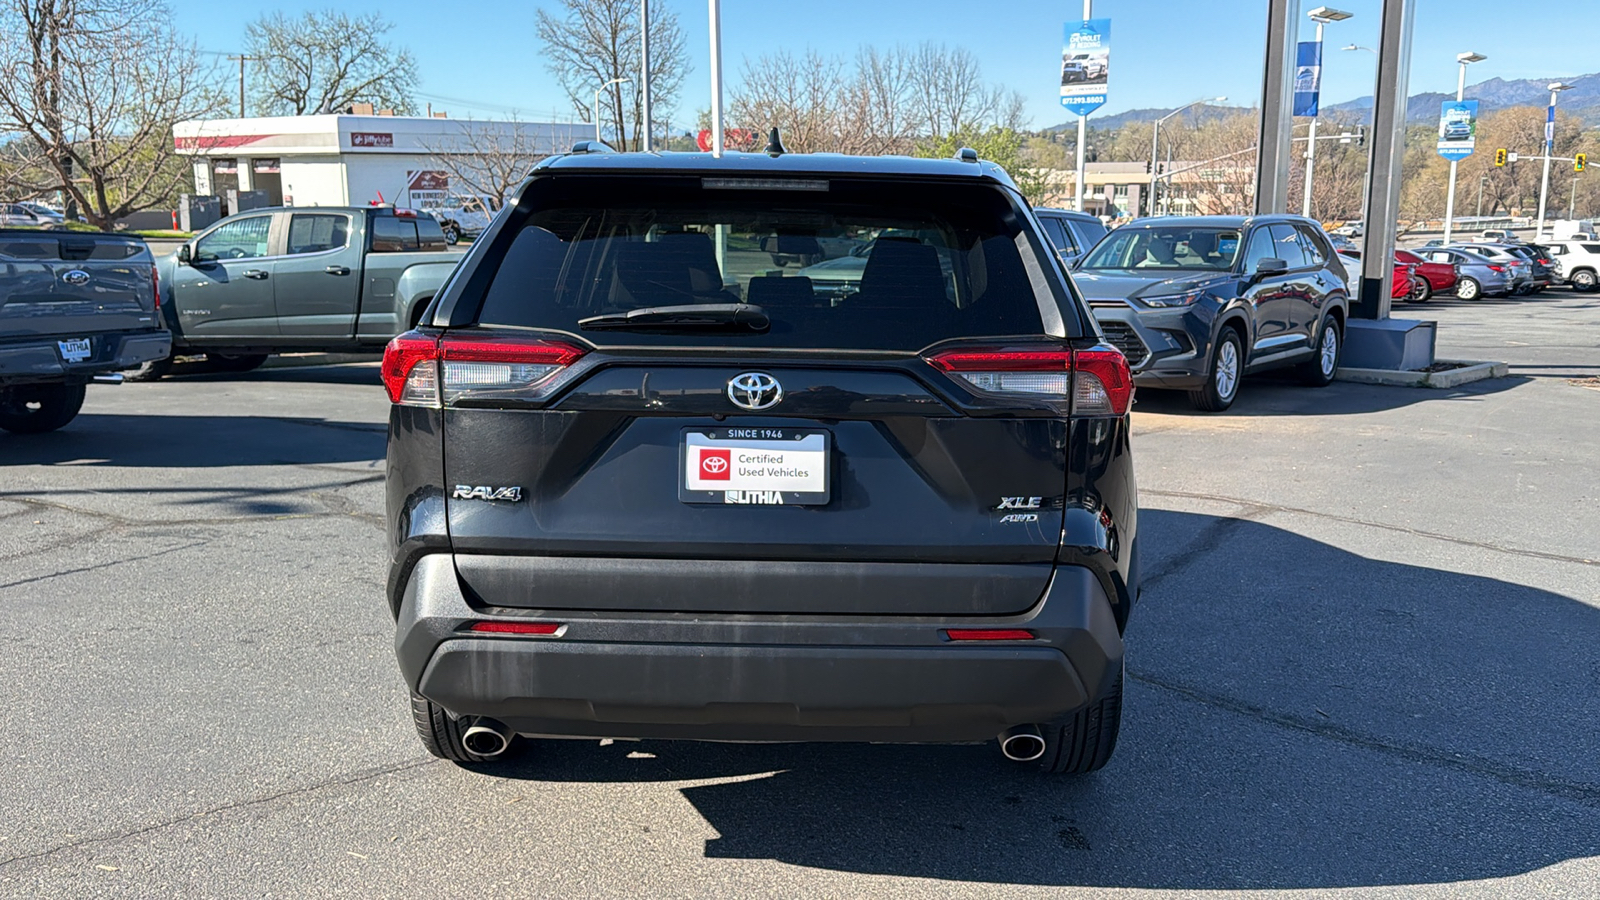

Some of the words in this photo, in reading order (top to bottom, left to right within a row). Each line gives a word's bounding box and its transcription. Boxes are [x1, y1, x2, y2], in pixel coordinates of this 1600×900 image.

[66, 343, 90, 353] LITHIA
[728, 429, 758, 439] SINCE
[760, 430, 783, 439] 1946
[738, 454, 784, 464] Certified
[738, 467, 765, 477] Used
[767, 468, 809, 478] Vehicles
[452, 484, 522, 502] RAV4
[738, 490, 784, 505] LITHIA
[996, 496, 1043, 509] XLE
[999, 513, 1039, 523] AWD
